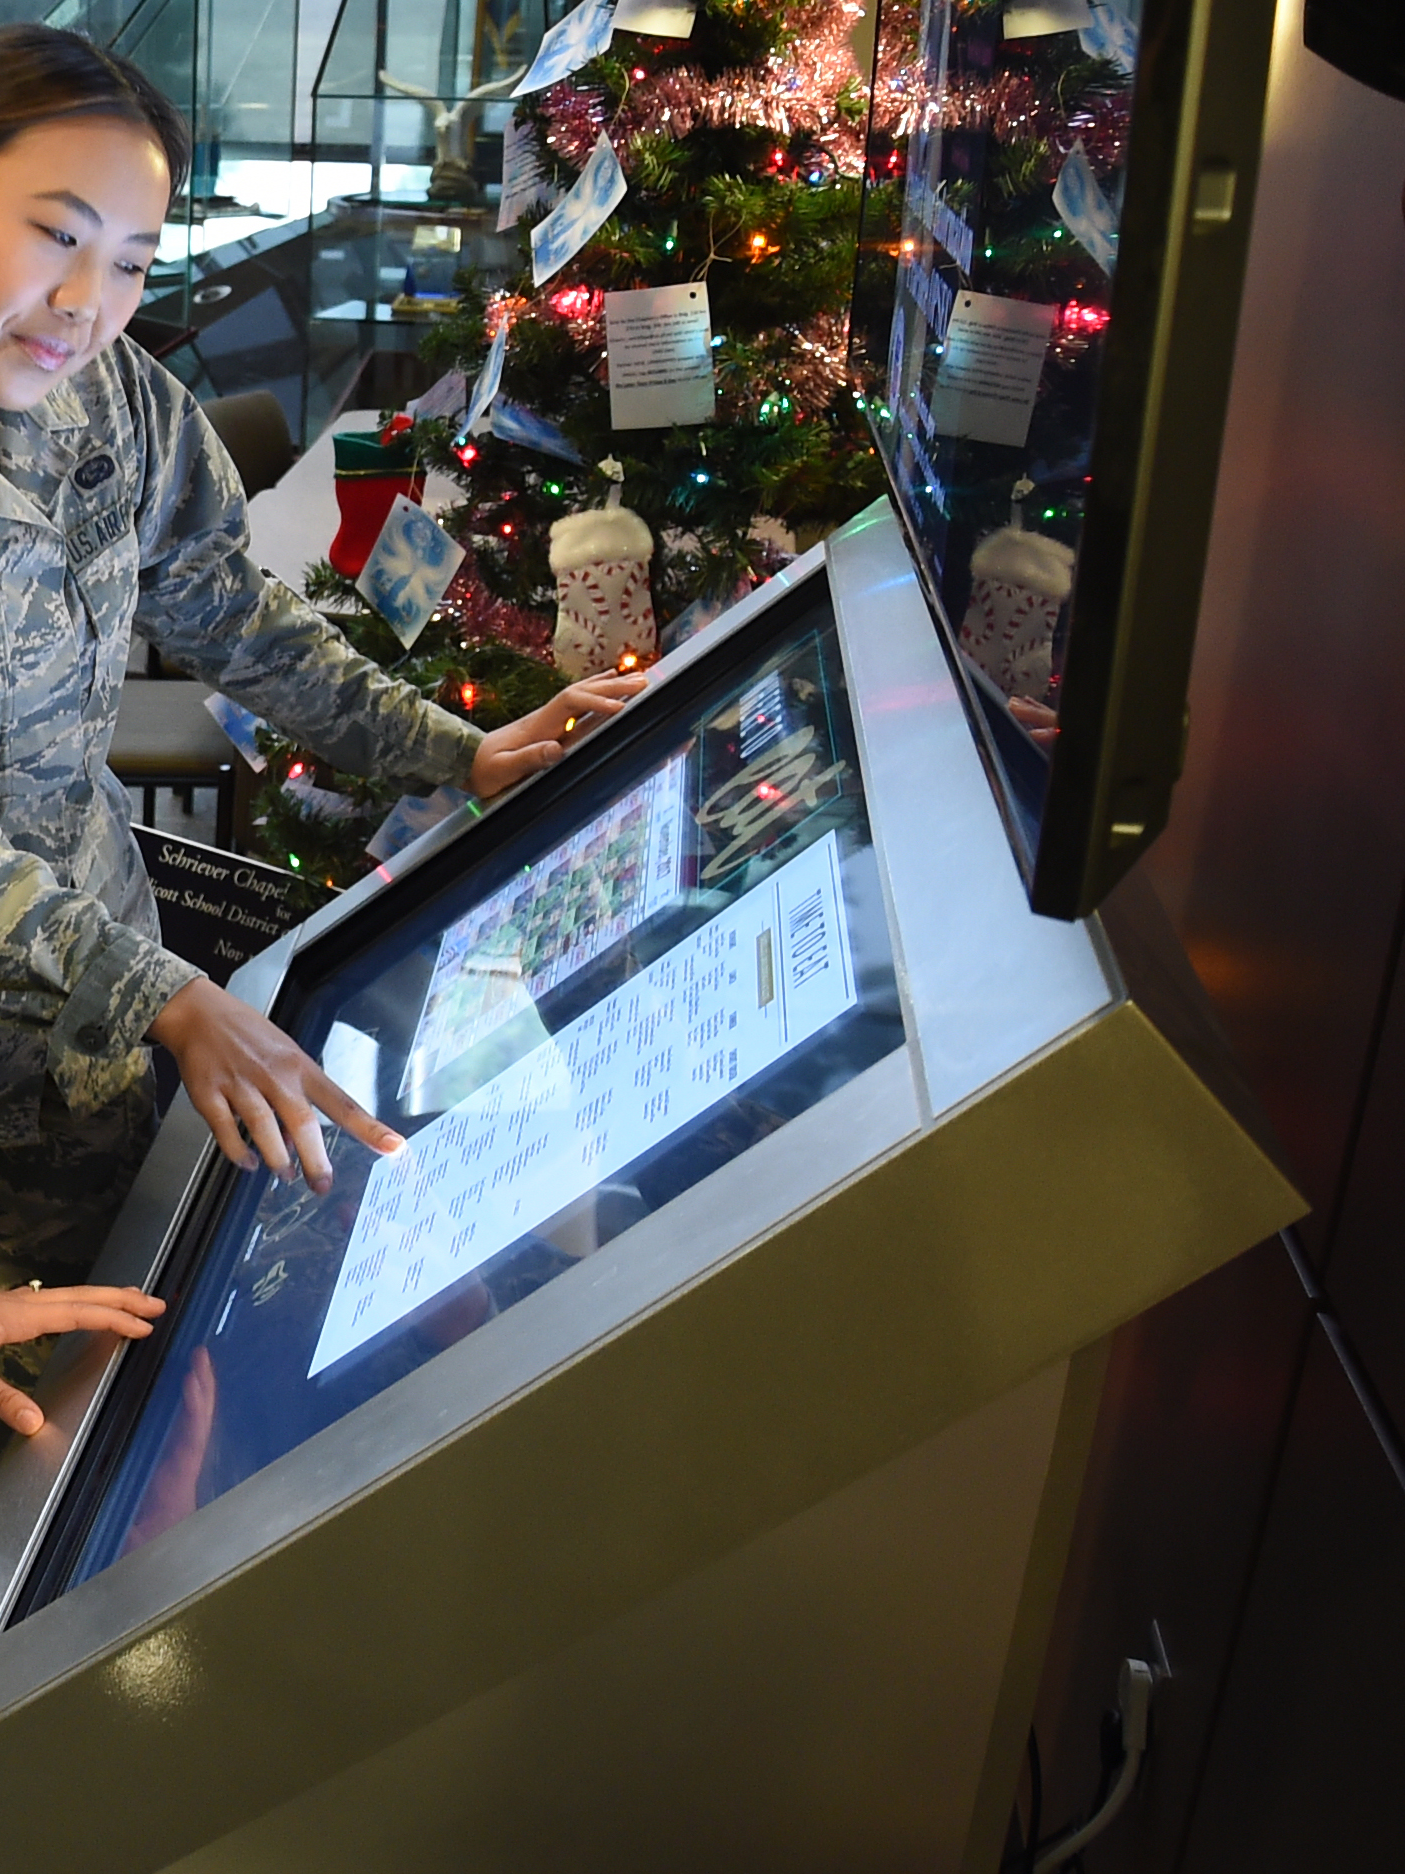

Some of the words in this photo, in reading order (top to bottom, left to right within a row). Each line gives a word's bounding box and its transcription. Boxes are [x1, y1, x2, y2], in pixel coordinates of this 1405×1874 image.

[66, 531, 98, 564] U.S.
[95, 511, 122, 546] AIR
[158, 844, 230, 881] Schriever
[181, 889, 226, 918] School
[227, 905, 280, 936] District
[276, 904, 293, 922] for
[789, 888, 825, 939] TIME
[214, 939, 244, 962] Nov
[791, 921, 826, 959] TO
[793, 944, 830, 990] EAT
